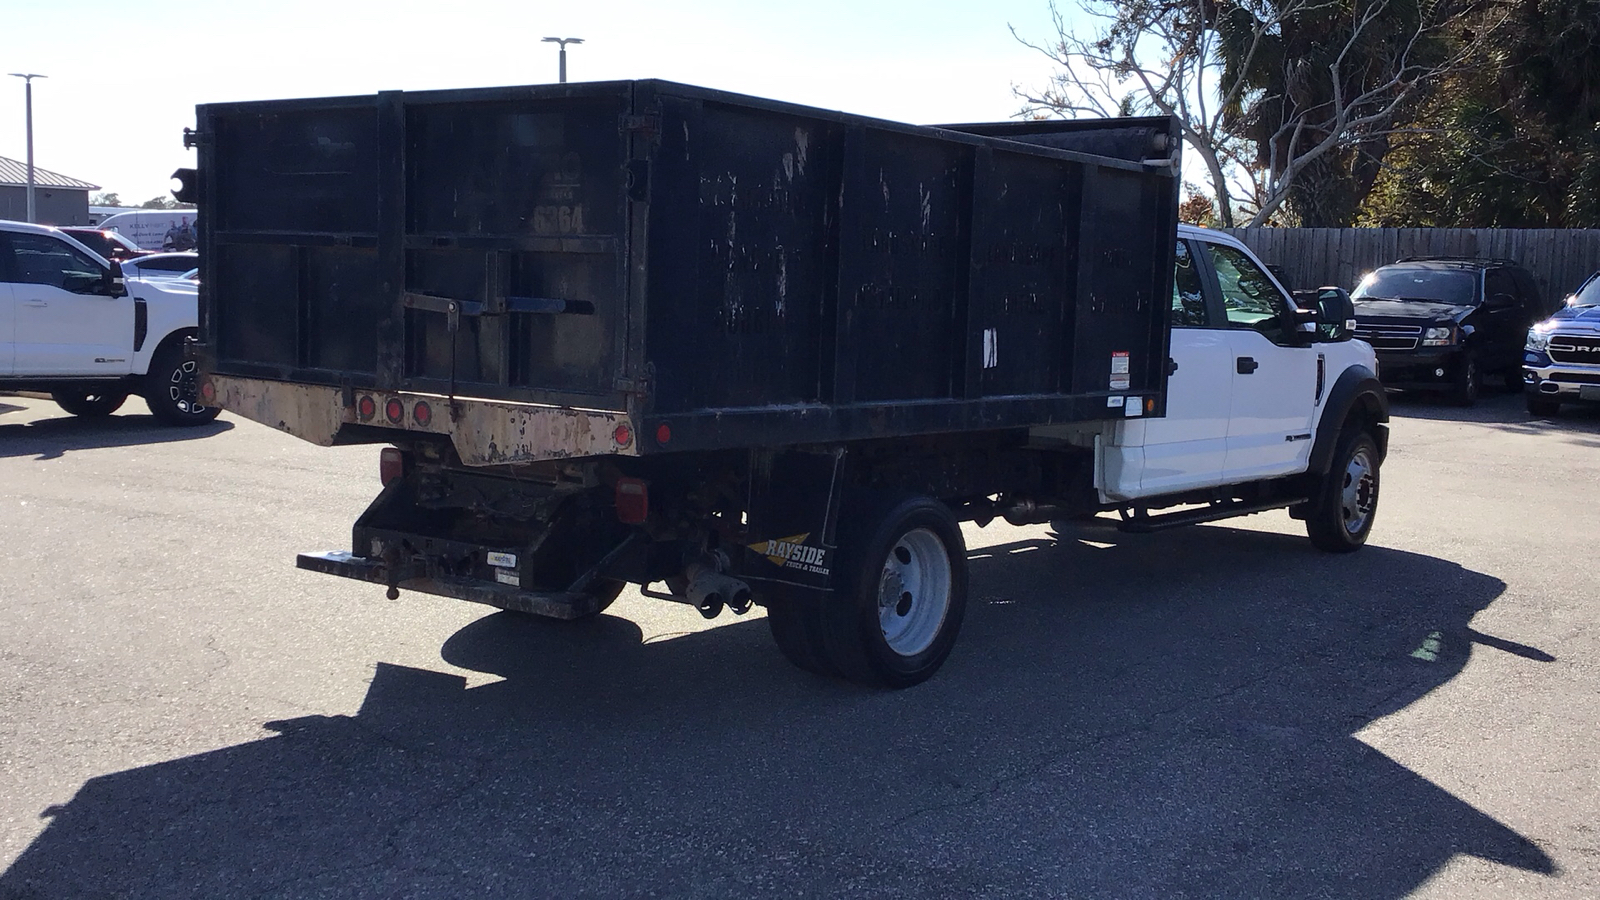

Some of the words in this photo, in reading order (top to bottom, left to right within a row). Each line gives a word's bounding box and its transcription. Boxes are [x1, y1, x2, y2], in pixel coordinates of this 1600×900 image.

[765, 539, 826, 566] RAYSIDE
[786, 560, 802, 570] TRUCK
[802, 564, 809, 572] &
[808, 565, 830, 576] TRAILER
